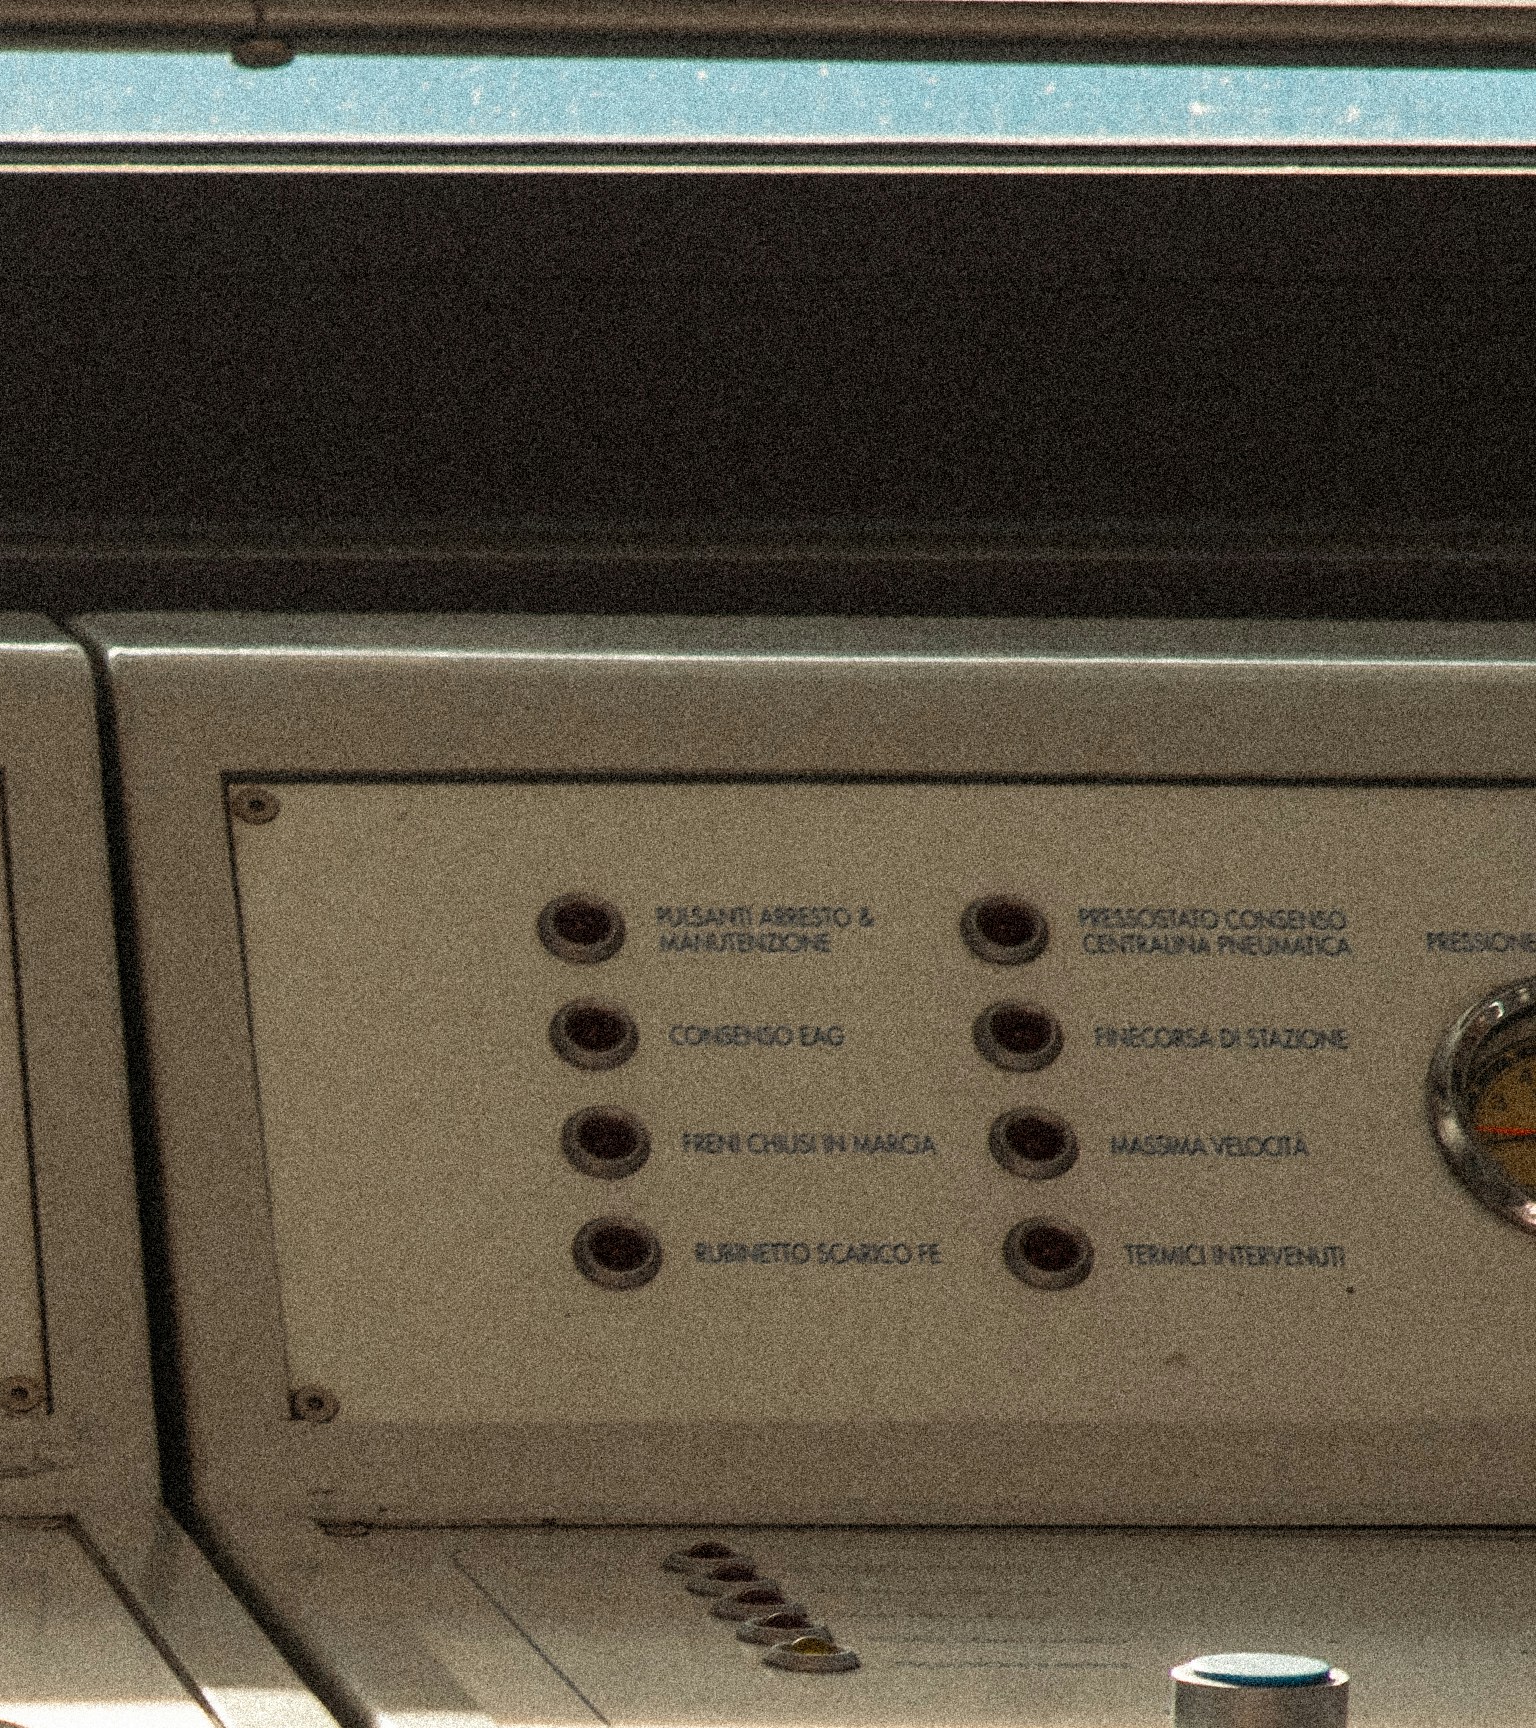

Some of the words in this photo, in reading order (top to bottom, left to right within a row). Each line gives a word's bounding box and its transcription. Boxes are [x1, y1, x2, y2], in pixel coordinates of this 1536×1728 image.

[655, 906, 752, 927] PULSANTI
[759, 906, 851, 928] ARRESTO
[1078, 908, 1218, 930] PRESSOSTATO
[1225, 909, 1347, 930] CONSENSO
[660, 932, 831, 953] MANUTENZIONE
[1083, 933, 1210, 955] CENTRALINA
[1217, 935, 1351, 956] PNEUMATICA
[669, 1025, 792, 1046] CONSENSO
[799, 1025, 845, 1046] EAG
[1094, 1026, 1211, 1049] FINECORSA
[1220, 1028, 1240, 1049] DI
[1247, 1028, 1349, 1050] STAZIONE
[682, 1132, 739, 1154] FRENI
[747, 1132, 817, 1154] CHIUSI
[825, 1133, 846, 1154] IN
[853, 1133, 936, 1155] MARCIA
[1110, 1135, 1206, 1156] MASSIMA
[695, 1242, 810, 1264] RUBINETTO
[817, 1242, 912, 1265] SCARICO
[1125, 1244, 1206, 1266] TERMICI
[1213, 1244, 1346, 1268] INTERVENUTI
